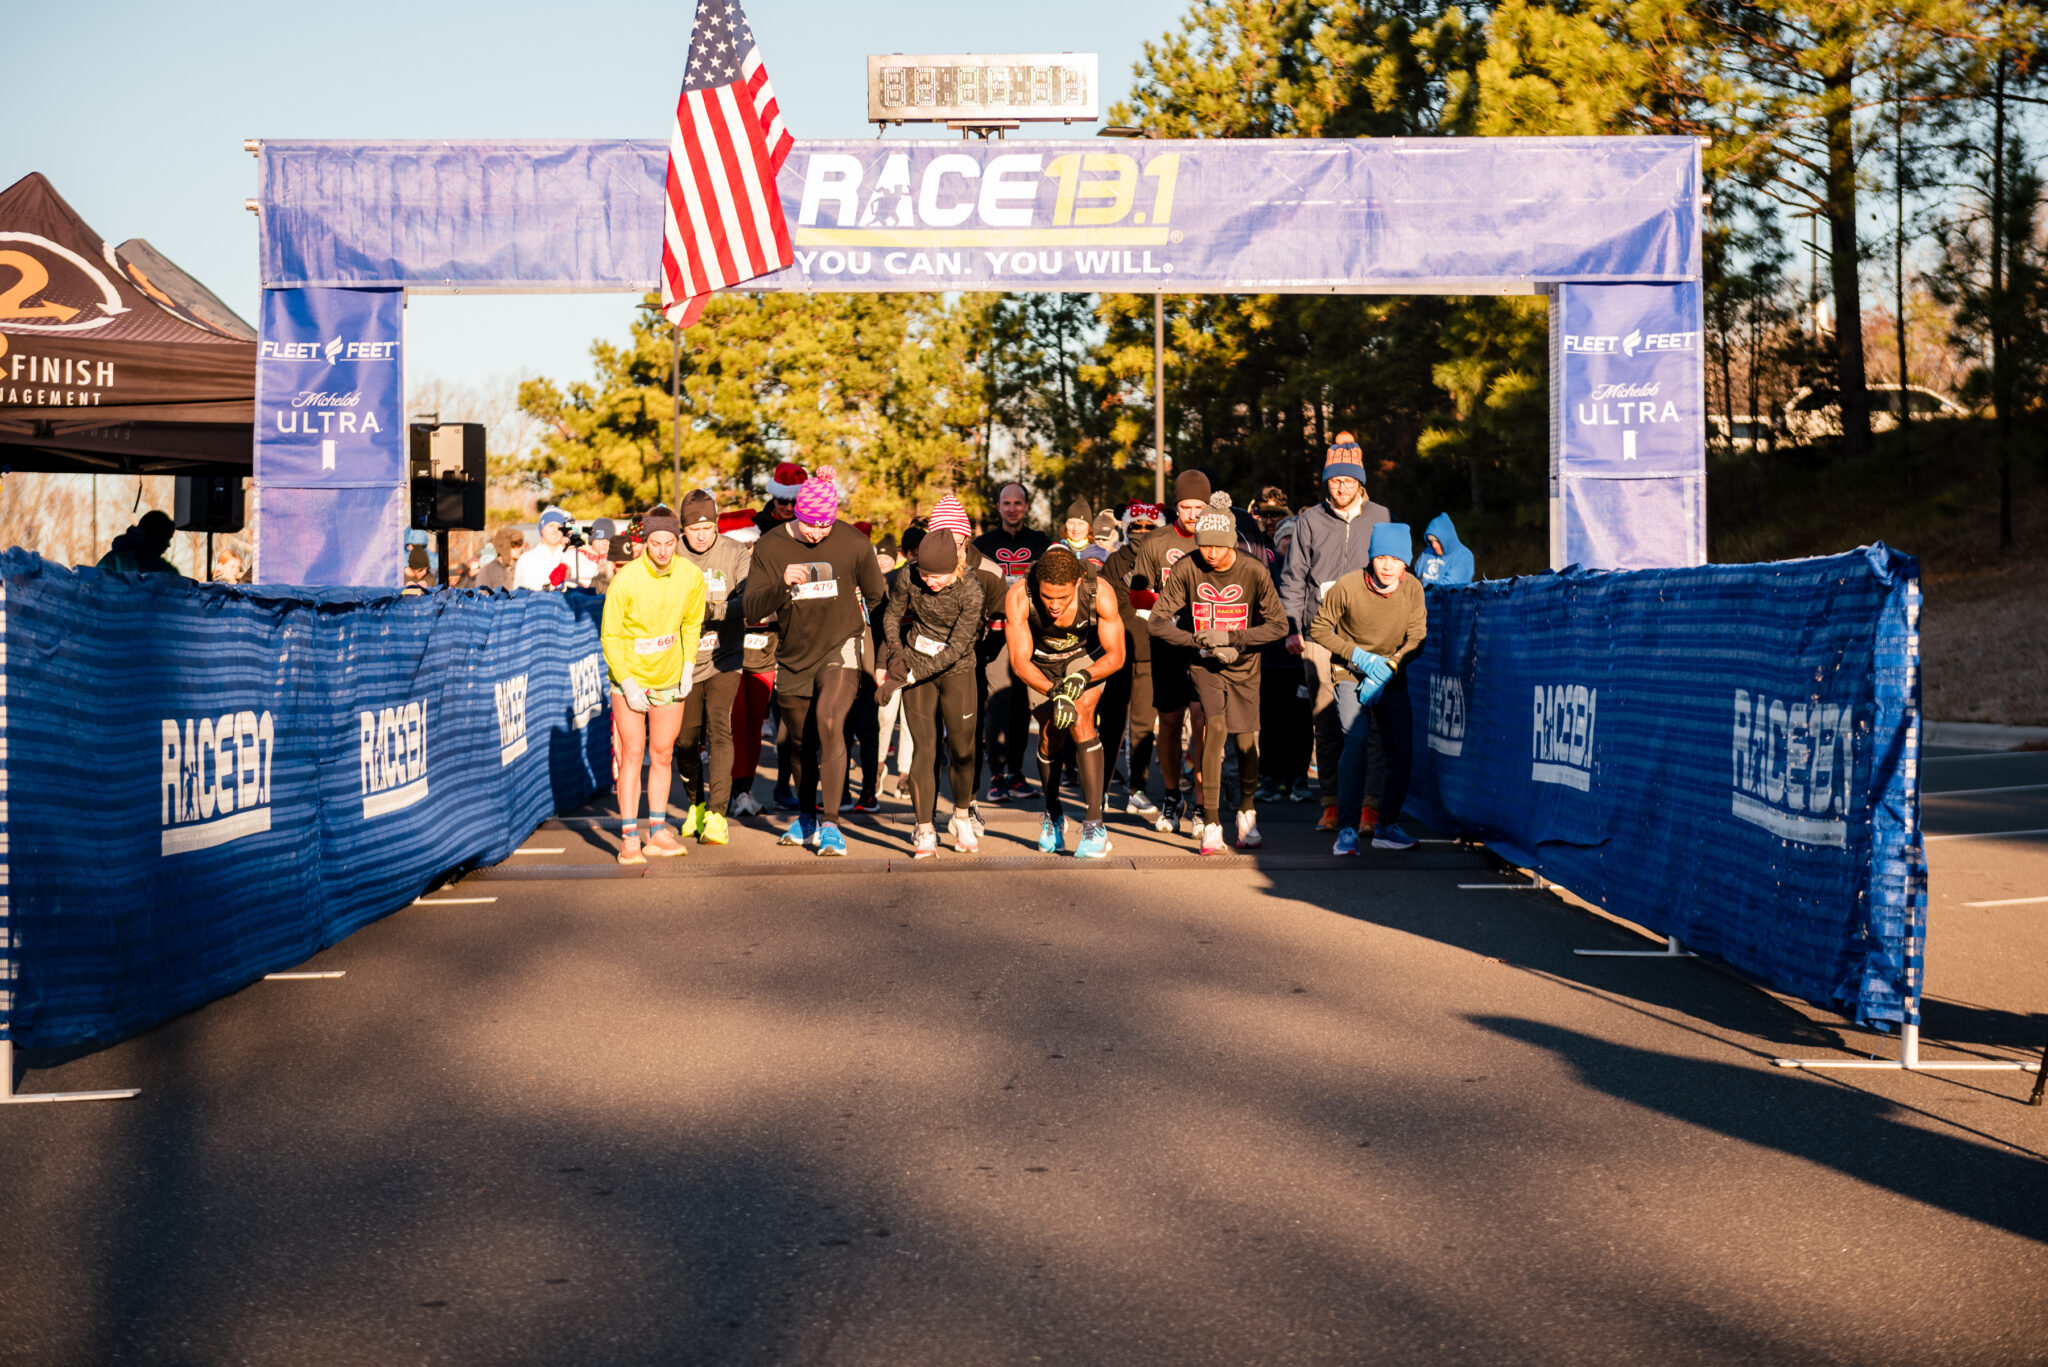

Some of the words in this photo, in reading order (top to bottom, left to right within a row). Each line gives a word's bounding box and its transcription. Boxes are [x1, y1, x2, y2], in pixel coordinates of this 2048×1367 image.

[795, 251, 871, 274] YOU
[884, 251, 972, 274] CAN.
[984, 251, 1063, 274] YOU
[260, 341, 321, 358] FLEET
[347, 342, 396, 358] FEET
[1563, 334, 1619, 352] FLEET
[1645, 332, 1696, 350] FEET
[11, 354, 114, 387] FINISH
[291, 391, 362, 408] Michelob
[1591, 381, 1661, 401] Michelob
[277, 410, 380, 434] ULTRA
[1578, 400, 1680, 425] ULTRA
[812, 582, 834, 592] 479
[657, 635, 674, 647] 661
[746, 637, 765, 647] 979
